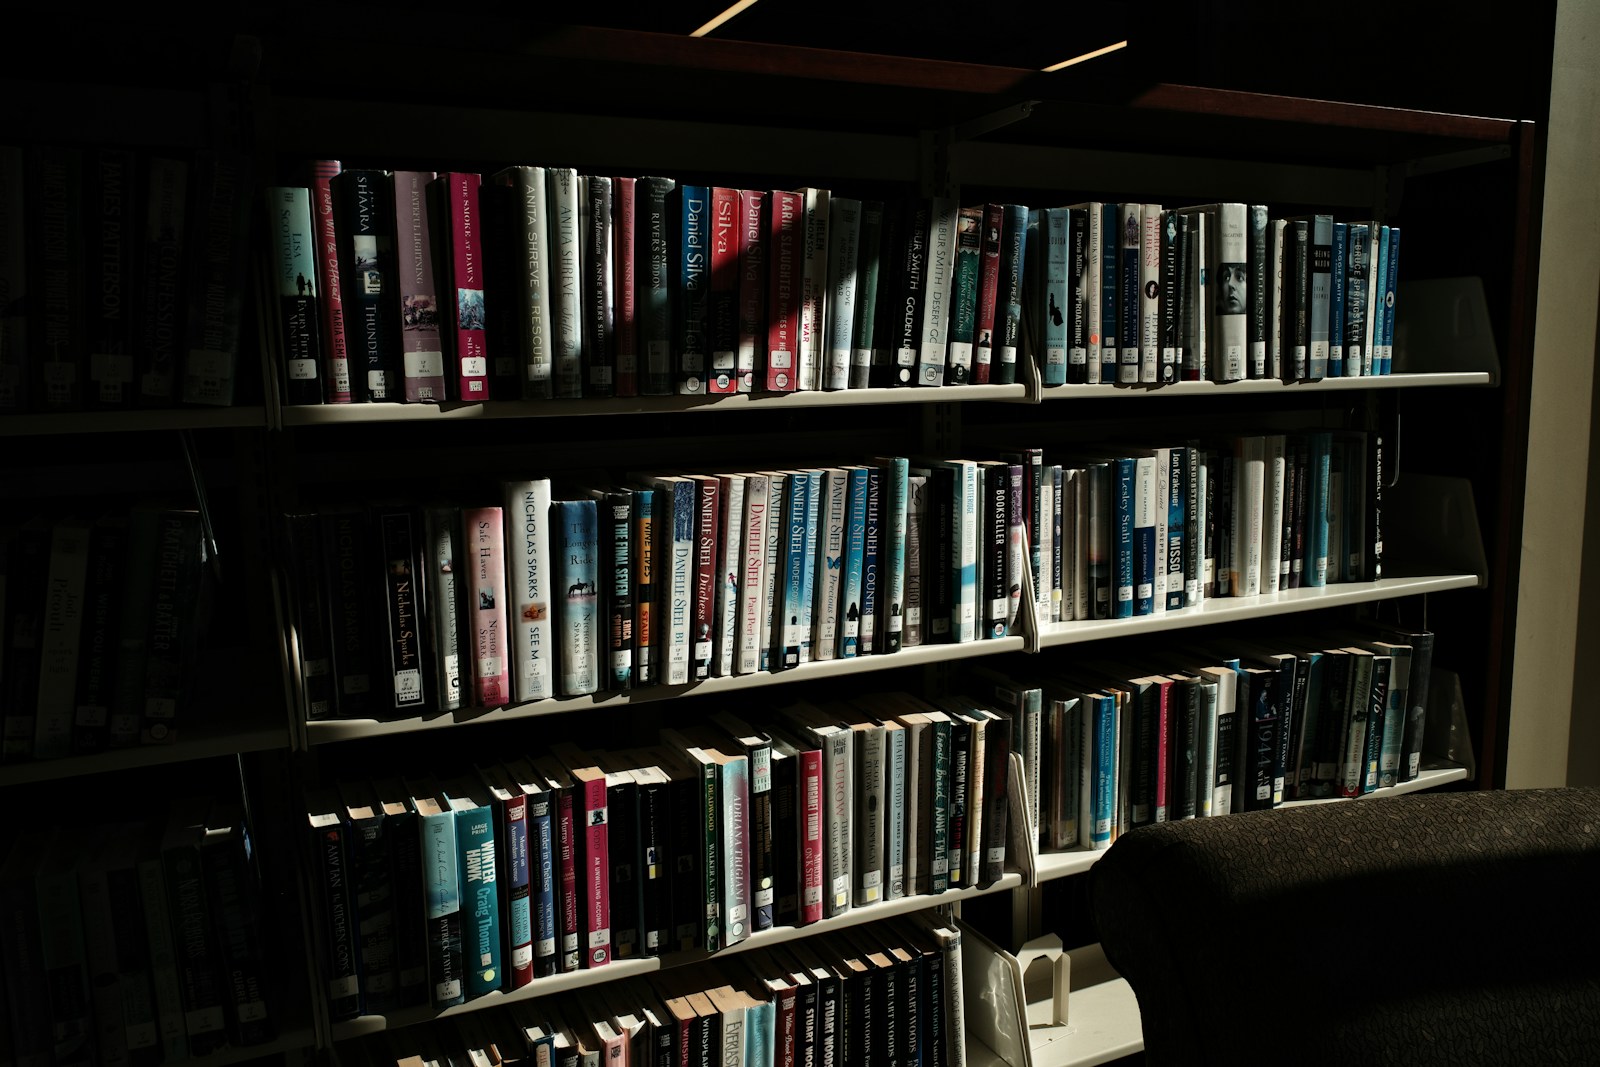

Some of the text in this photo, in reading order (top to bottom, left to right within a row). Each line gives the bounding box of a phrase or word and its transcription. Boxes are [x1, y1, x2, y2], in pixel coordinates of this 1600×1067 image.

[325, 219, 337, 237] Will
[357, 176, 370, 232] SHAARA
[463, 199, 472, 237] SMOKE
[717, 200, 732, 256] Silva
[280, 210, 294, 282] SCOTTOLINE
[292, 233, 302, 258] LISA
[412, 190, 424, 284] FATEFUL LIGHTNING
[465, 239, 471, 250] AT
[560, 205, 573, 297] ANITA SHREVE
[651, 212, 661, 295] RIVERS SIDDONS
[686, 199, 704, 290] Daniel Silva
[747, 196, 764, 281] Daniel Silva
[779, 196, 794, 300] KARIN SLAUGHTER
[806, 208, 817, 260] SIMONSON
[815, 219, 825, 250] HELEN
[934, 209, 948, 285] WILBUR SMITH
[1145, 216, 1153, 267] HEIRESS
[465, 253, 474, 283] DAWN
[526, 185, 543, 364] ANITA SHREVE RESCUE
[909, 253, 922, 290] SMITH
[297, 300, 307, 329] EVERY
[802, 277, 811, 343] BEFORE WAR
[811, 296, 821, 334] SUMMER
[903, 296, 916, 337] GOLDEN
[931, 291, 942, 326] DESERT
[1074, 287, 1083, 344] APPROACHING
[1165, 281, 1174, 332] HEDREN
[1352, 244, 1362, 342] BRUCE SPRINGSTEEN
[333, 309, 344, 335] MARIA
[365, 304, 378, 364] THUNDER
[779, 331, 787, 340] OF
[966, 466, 975, 515] OLIVE KITTERIDGE
[1171, 453, 1181, 508] Jon Krakauer
[1190, 449, 1198, 521] THUNDERSTRUCK
[1273, 481, 1281, 516] MAKER
[699, 485, 715, 567] DANIELLE STEEL
[768, 481, 783, 568] DANIELLE STEEL
[791, 475, 806, 555] DANIELLE STEEL
[829, 476, 845, 553] DANIELLE STEEL
[851, 475, 867, 553] DANIELLE STEEL
[866, 474, 878, 558] DANIELLE STEEL
[994, 489, 1006, 545] BOOKSELLER
[1119, 476, 1130, 543] Lesley Stahl
[479, 520, 491, 579] Safe Haven
[525, 491, 538, 598] NICHOLAS SPARKS
[614, 522, 629, 596] THE FINAL SEVEN
[747, 504, 764, 590] DANIELLE STEEL
[673, 548, 688, 627] DANIELLE STEEL
[697, 572, 709, 620] Duchess
[747, 597, 757, 617] Past
[790, 557, 800, 614] UNDERCOVER
[827, 575, 838, 613] Precious
[395, 580, 415, 665] Nicholas Sparks
[530, 627, 539, 646] SEE
[573, 621, 581, 654] SPARKS
[622, 619, 631, 640] ERICA
[641, 610, 649, 643] STAUB
[1372, 681, 1385, 716] 1776
[895, 734, 904, 780] CHARLES
[1257, 723, 1273, 765] 1944
[1282, 731, 1288, 740] AT
[835, 758, 845, 817] TUROW
[955, 750, 967, 783] ANDREW
[471, 823, 488, 831] LARGE
[707, 783, 715, 831] DEADWOOD
[807, 776, 819, 841] MARGARET TRUMAN
[934, 806, 944, 836] ANNE
[480, 839, 496, 884] WINTER
[511, 825, 519, 859] Amsterdam
[541, 820, 551, 892] Murder in Chelsea
[560, 816, 570, 861] Murray Hill
[594, 857, 601, 865] AN
[733, 794, 743, 900] ADRIANA TRIGIANI
[804, 847, 813, 860] ON
[465, 848, 482, 883] HAWK
[813, 853, 821, 885] MURDER
[475, 887, 490, 917] Craig
[565, 891, 573, 930] THOMPSON
[440, 919, 449, 951] PATRICK
[594, 952, 605, 960] LUXE
[804, 1008, 815, 1042] STUART
[824, 1000, 835, 1034] STUART
[863, 988, 872, 1020] STUART
[887, 982, 896, 1058] STUART WOODS
[908, 976, 917, 1053] STUART WOODS
